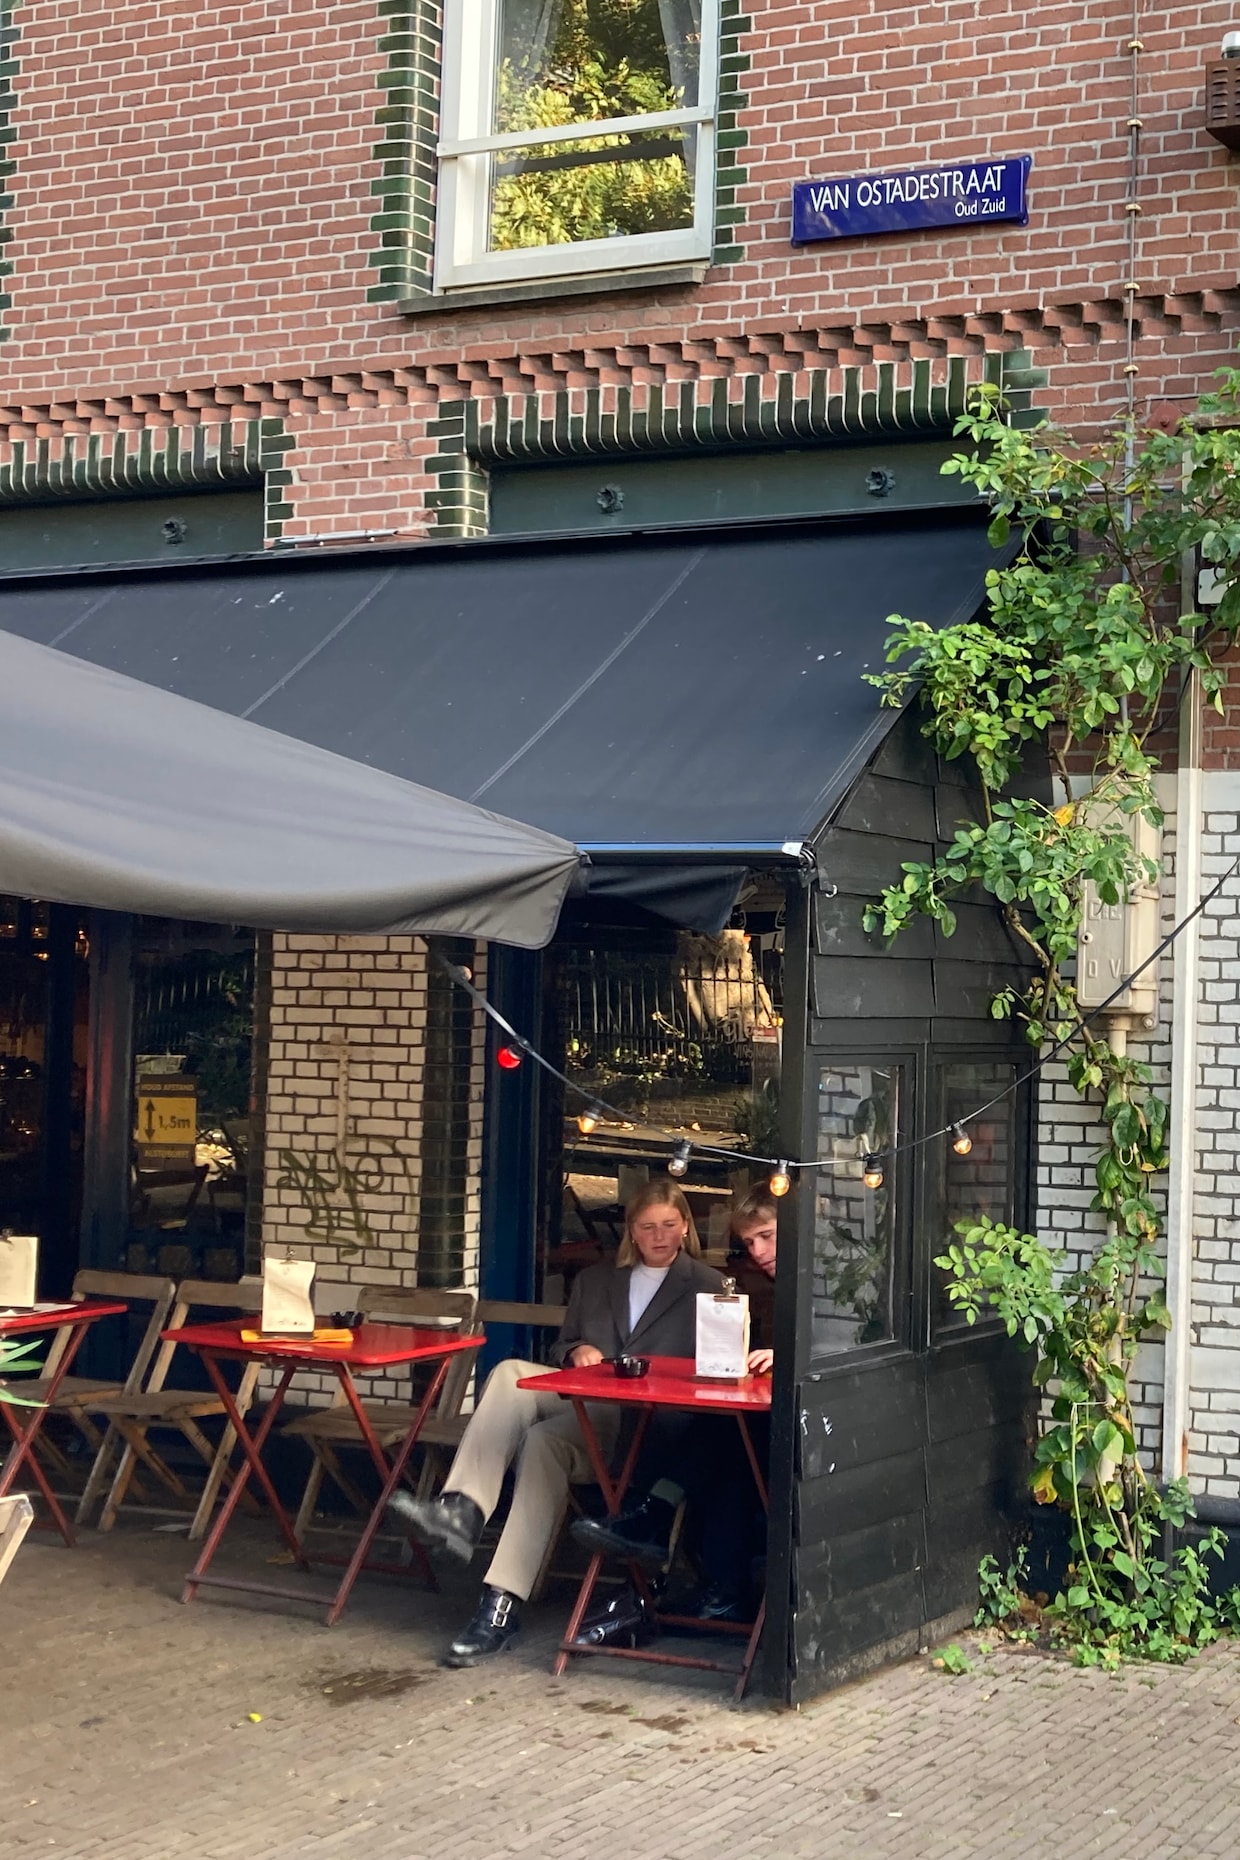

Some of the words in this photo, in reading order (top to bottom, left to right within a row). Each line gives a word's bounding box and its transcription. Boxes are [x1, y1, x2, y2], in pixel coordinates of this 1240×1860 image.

[810, 184, 850, 212] VAN
[856, 165, 1006, 207] OSTADESTRAAT
[954, 200, 977, 217] Oud
[981, 196, 1006, 215] Zuid
[158, 1115, 191, 1131] 1,5m
